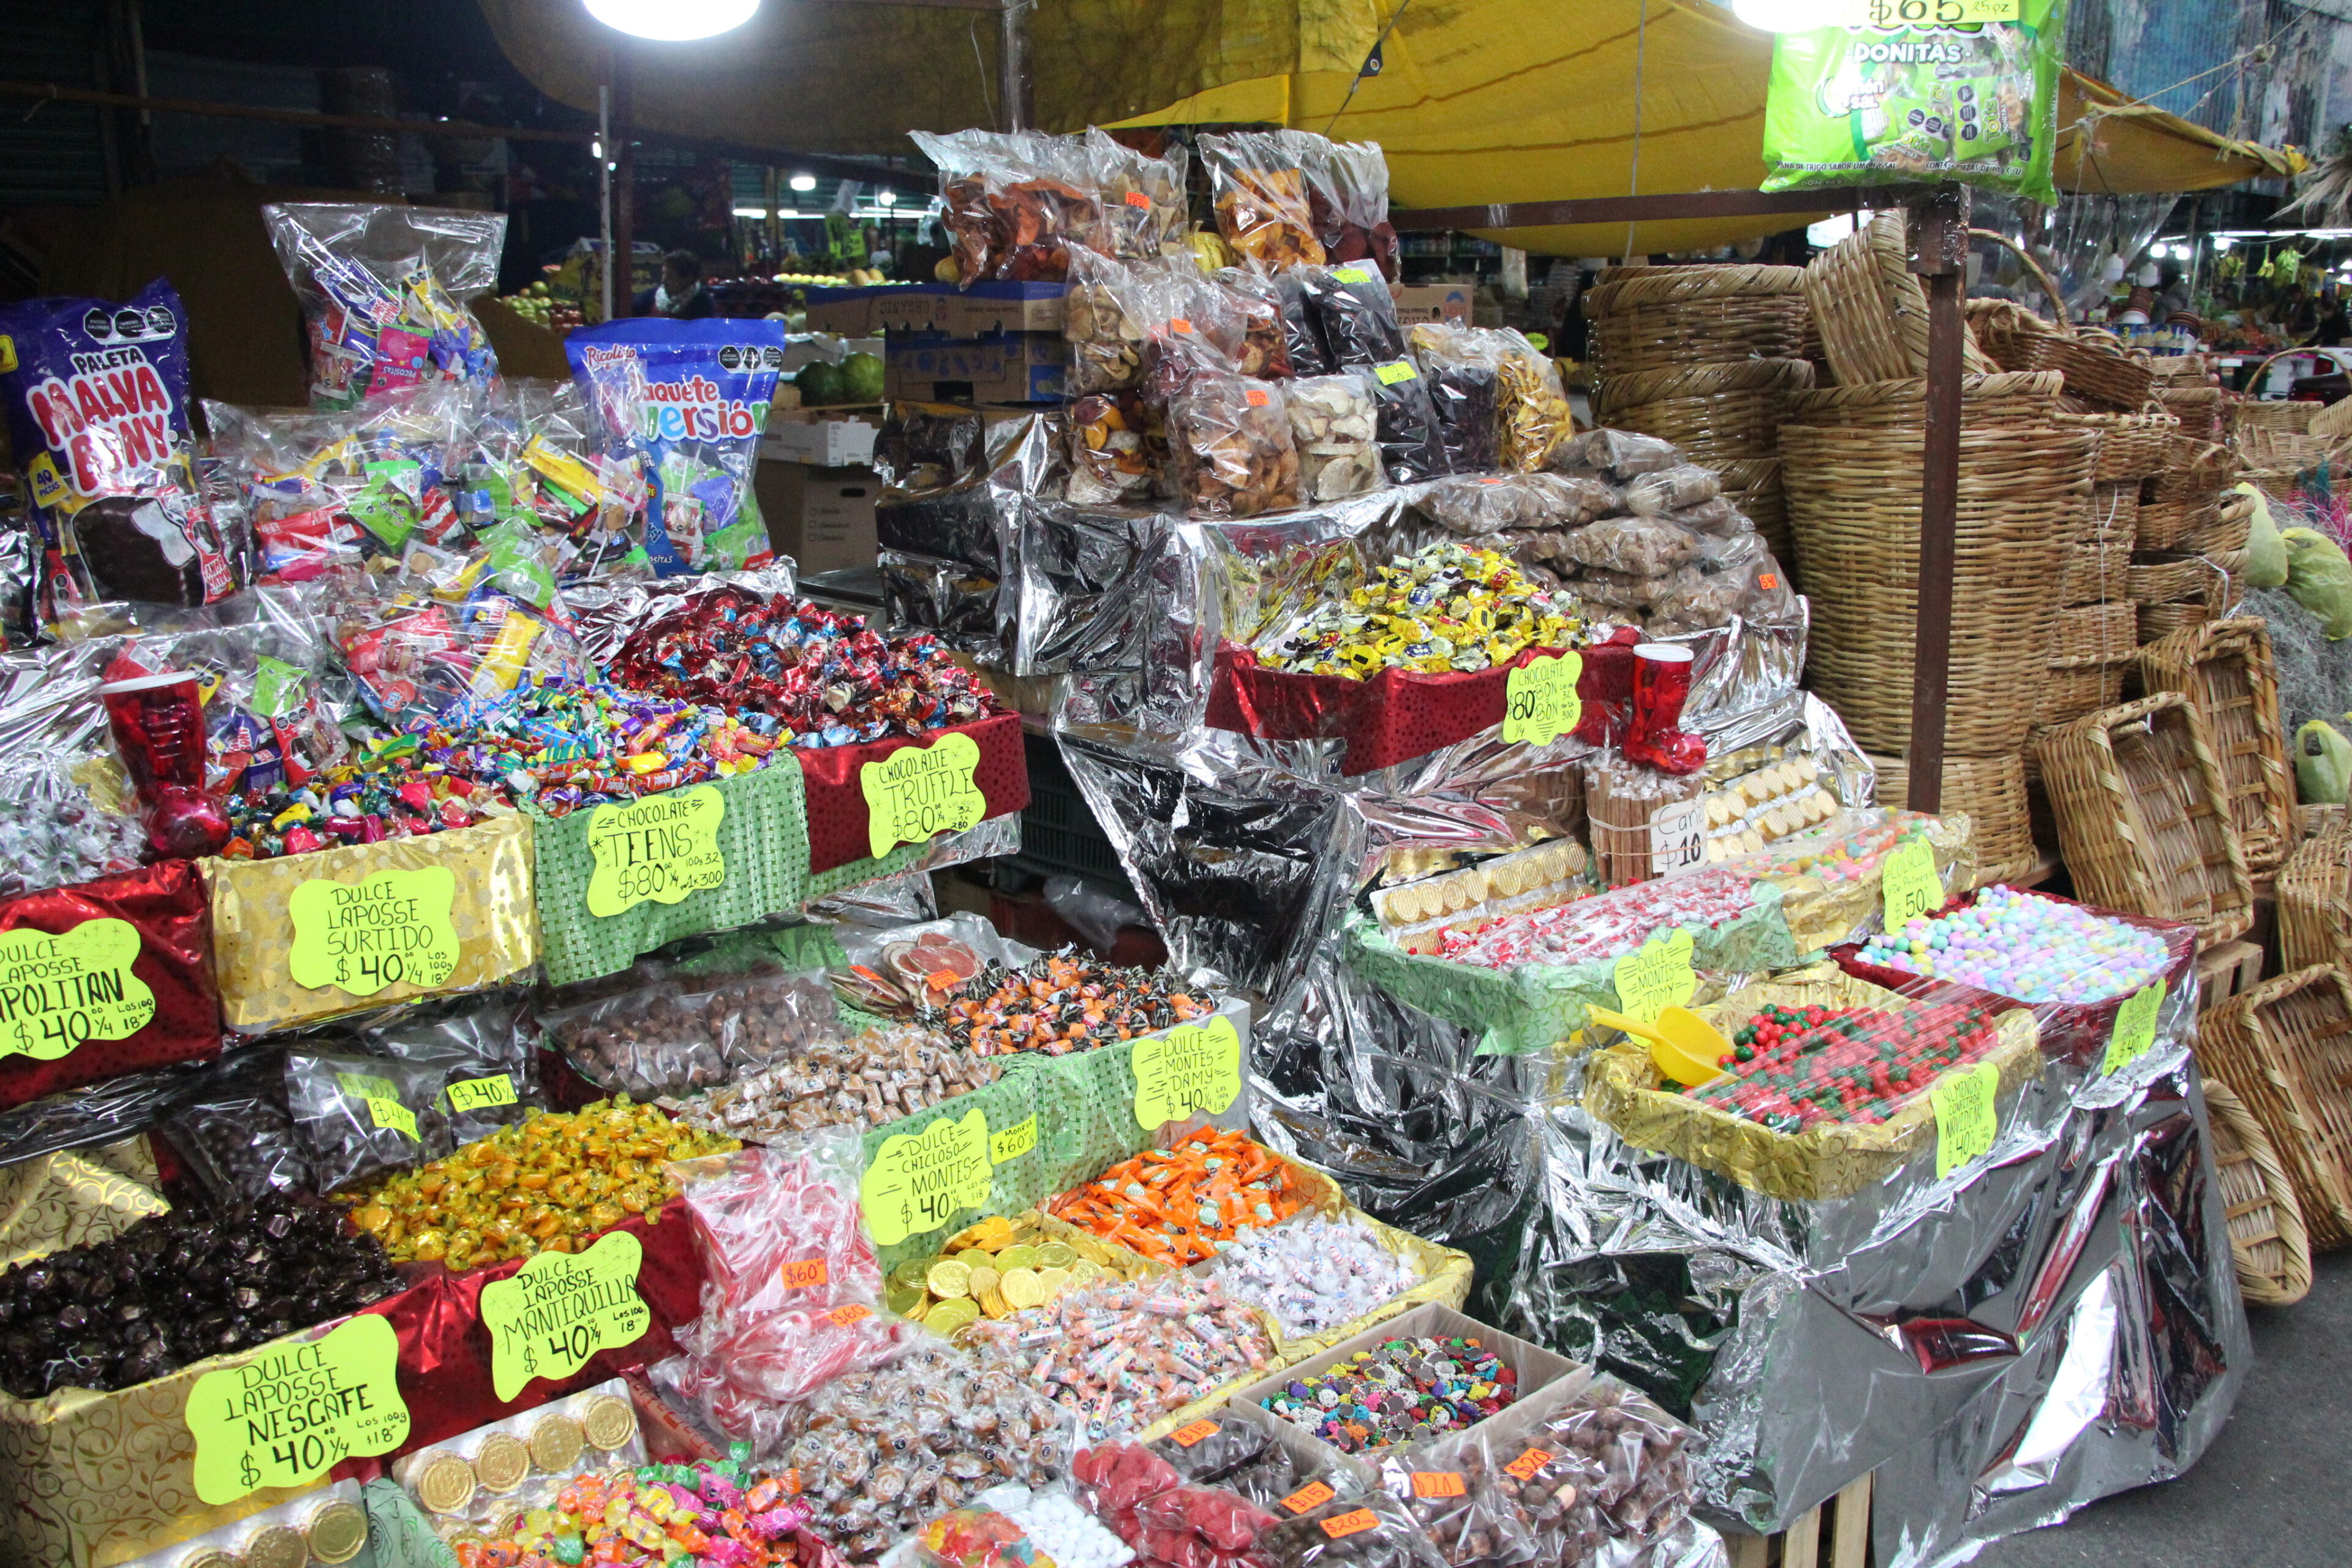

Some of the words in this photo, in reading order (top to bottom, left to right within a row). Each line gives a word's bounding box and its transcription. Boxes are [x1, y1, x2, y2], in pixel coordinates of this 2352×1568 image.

[1853, 42, 1964, 64] DONITAS
[1891, 145, 1918, 159] DONITAS
[1901, 134, 1932, 156] otis
[1795, 162, 1804, 170] DE
[1806, 162, 1827, 172] TRIGO
[1828, 162, 1852, 171] SABOR
[74, 347, 145, 376] PALETA
[585, 344, 636, 366] Ricolino
[641, 377, 718, 404] aquete
[32, 366, 168, 447] MALVA
[637, 401, 770, 440] versión
[70, 413, 169, 492] BONY
[36, 469, 53, 486] 40
[649, 554, 673, 564] OSiTAS
[1518, 661, 1565, 686] CHOCOLATE
[1534, 680, 1557, 701] BON
[1535, 699, 1558, 722] BON
[883, 766, 977, 813] TRUFFLE
[617, 800, 690, 828] CHOCOLATE
[957, 805, 973, 815] 32
[950, 821, 968, 829] 280
[604, 823, 693, 867] TEENS
[1660, 831, 1702, 870] $10
[703, 851, 720, 865] 32
[699, 870, 723, 886] 300
[330, 881, 396, 906] DULCE
[328, 898, 420, 930] LAPOSSE
[327, 925, 434, 956] SURTIDO
[428, 951, 447, 960] LOS
[1635, 948, 1666, 973] DULCE
[407, 962, 423, 984] 1/4
[1638, 960, 1675, 992] MONTES
[0, 968, 124, 1024] POLITAN
[1643, 984, 1675, 1009] TOMY
[94, 1016, 113, 1037] 1/4
[1163, 1031, 1204, 1057] DULCE
[1166, 1050, 1214, 1074] MONTES
[1169, 1068, 1213, 1091] DAMY
[1942, 1072, 1983, 1103] ALMENDRA
[901, 1125, 956, 1156] DULCE
[901, 1142, 960, 1174] CHICLOSO
[911, 1156, 973, 1197] MONTES
[516, 1258, 575, 1291] DULCE
[523, 1267, 598, 1311] LAPOSSE
[503, 1273, 641, 1355] MANTEQUILLA
[235, 1343, 327, 1389] DULCE
[224, 1366, 341, 1422] LAPOSSE
[247, 1383, 374, 1446] NESCAFE
[356, 1417, 379, 1428] LOS
[1178, 1422, 1210, 1442] $15
[330, 1436, 350, 1461] 1/4
[1507, 1451, 1551, 1477] $20
[1289, 1487, 1325, 1509] $15
